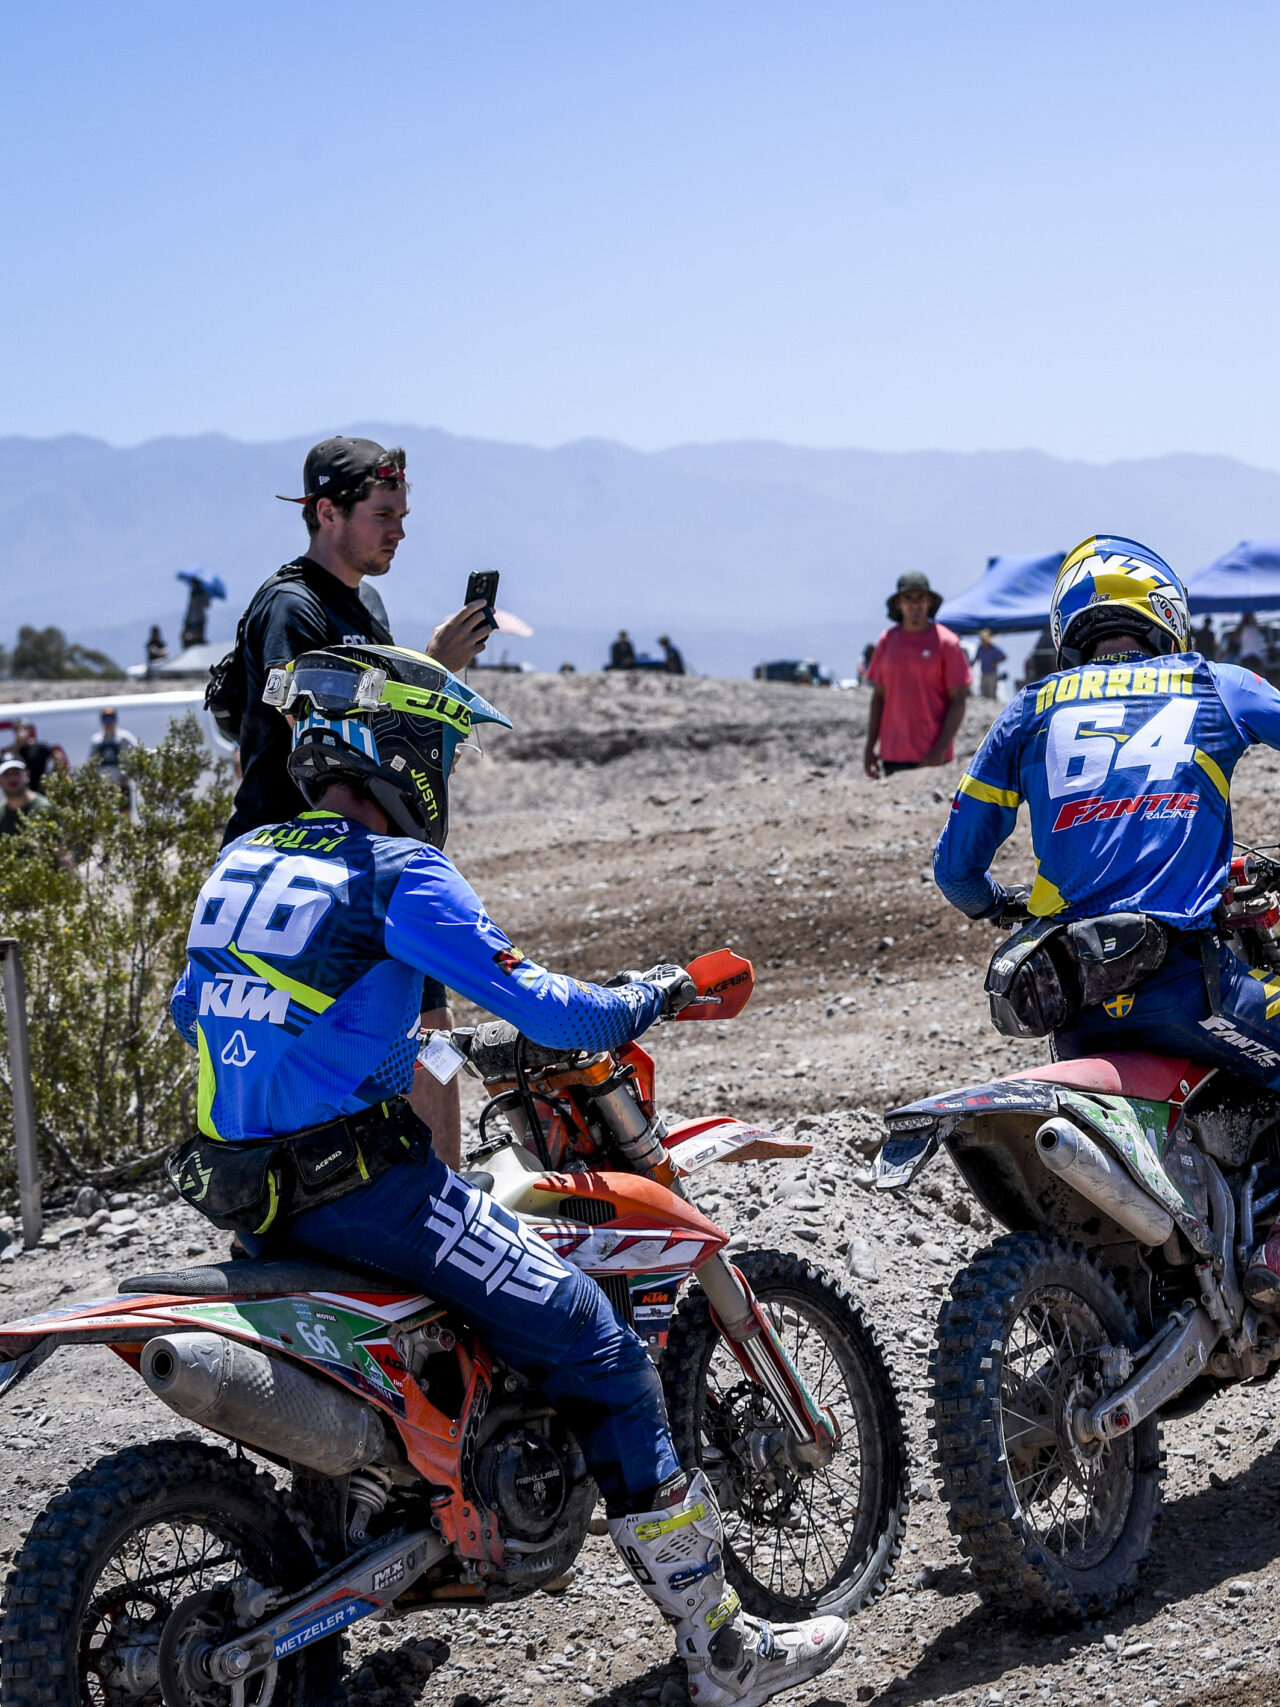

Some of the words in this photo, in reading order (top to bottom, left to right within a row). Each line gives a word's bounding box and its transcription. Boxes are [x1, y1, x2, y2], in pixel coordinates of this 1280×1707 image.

[1045, 698, 1199, 800] 64
[410, 768, 439, 821] JUST1
[1052, 793, 1199, 832] FANTIC
[187, 850, 363, 958] 66
[199, 972, 291, 1025] KTM
[315, 1312, 337, 1321] MOTUL
[642, 1292, 668, 1304] KTM
[296, 1321, 341, 1359] 66
[275, 1610, 345, 1656] METZELER
